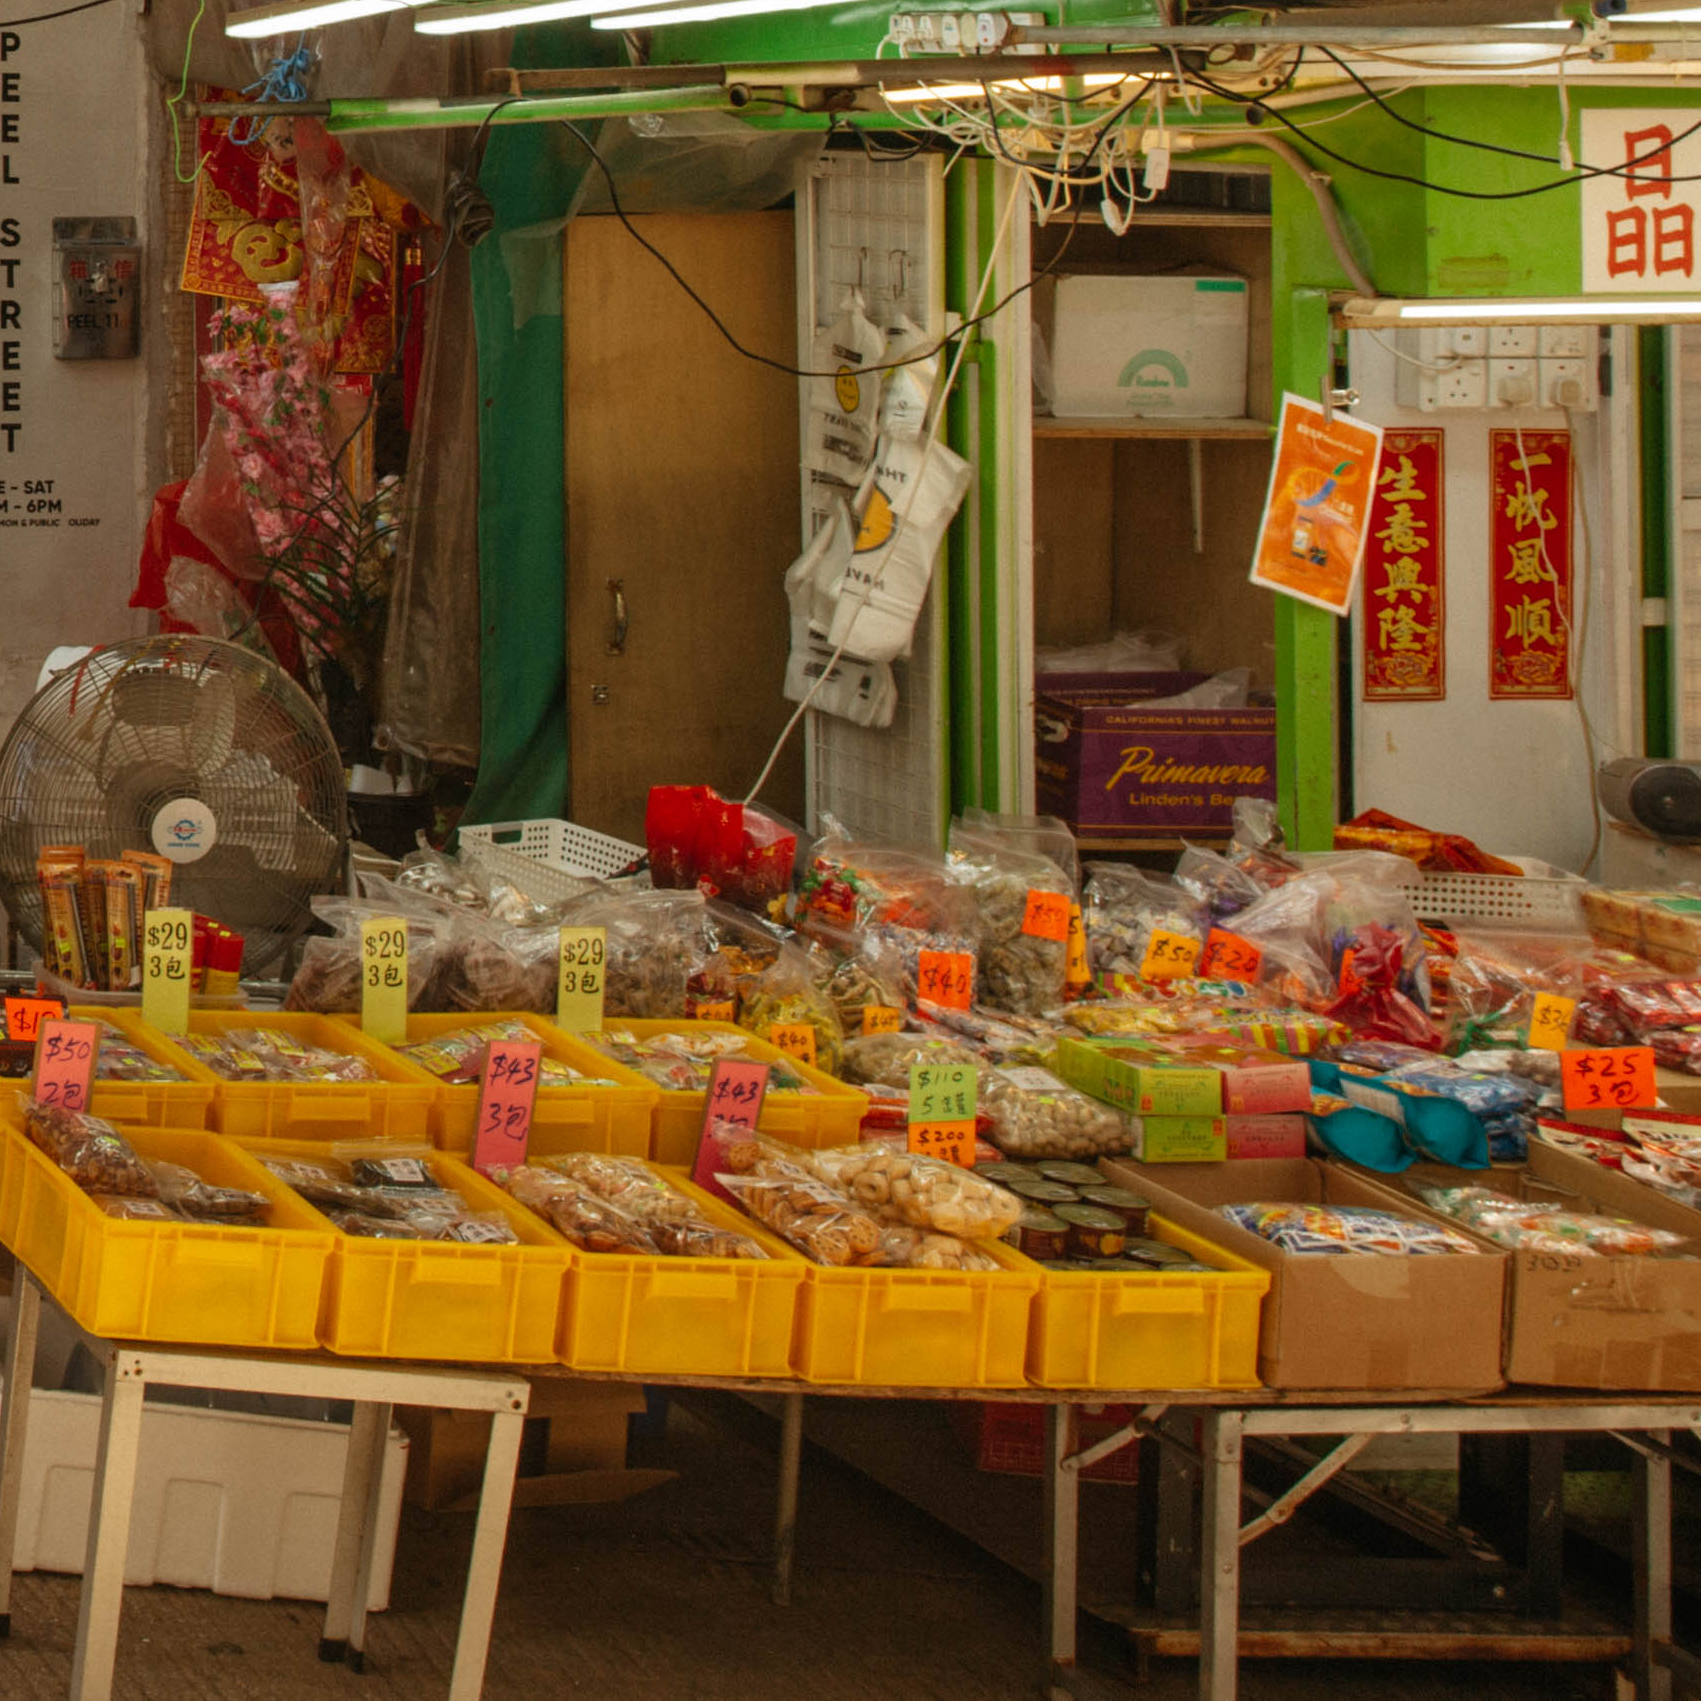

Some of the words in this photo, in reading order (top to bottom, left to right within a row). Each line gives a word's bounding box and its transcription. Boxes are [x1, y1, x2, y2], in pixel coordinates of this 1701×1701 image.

[0, 31, 21, 185] PEEL
[0, 217, 22, 453] STREET
[23, 480, 55, 495] SAT
[26, 499, 63, 513] 6PM
[29, 518, 61, 527] PUBLIC
[1374, 454, 1430, 651] 生意興隆
[1504, 452, 1559, 649] 一帆風順
[1105, 715, 1184, 725] CALIFORNIA'S
[1187, 716, 1226, 725] FINEST
[1104, 745, 1270, 792] Primavera
[1129, 792, 1204, 806] Linden's
[147, 922, 188, 950] $29
[364, 930, 406, 959] $29
[563, 937, 605, 966] $29
[1152, 938, 1194, 964] $50
[1208, 941, 1258, 973] $20
[149, 955, 186, 980] 3包
[367, 963, 404, 988] 3包
[923, 967, 968, 996] $40
[564, 970, 600, 995] 3包
[45, 1032, 91, 1063] $50
[490, 1053, 535, 1087] $43
[917, 1069, 964, 1090] $110
[1575, 1054, 1639, 1078] $25
[714, 1077, 760, 1105] $43
[484, 1101, 530, 1143] 3包
[917, 1128, 966, 1145] $200
